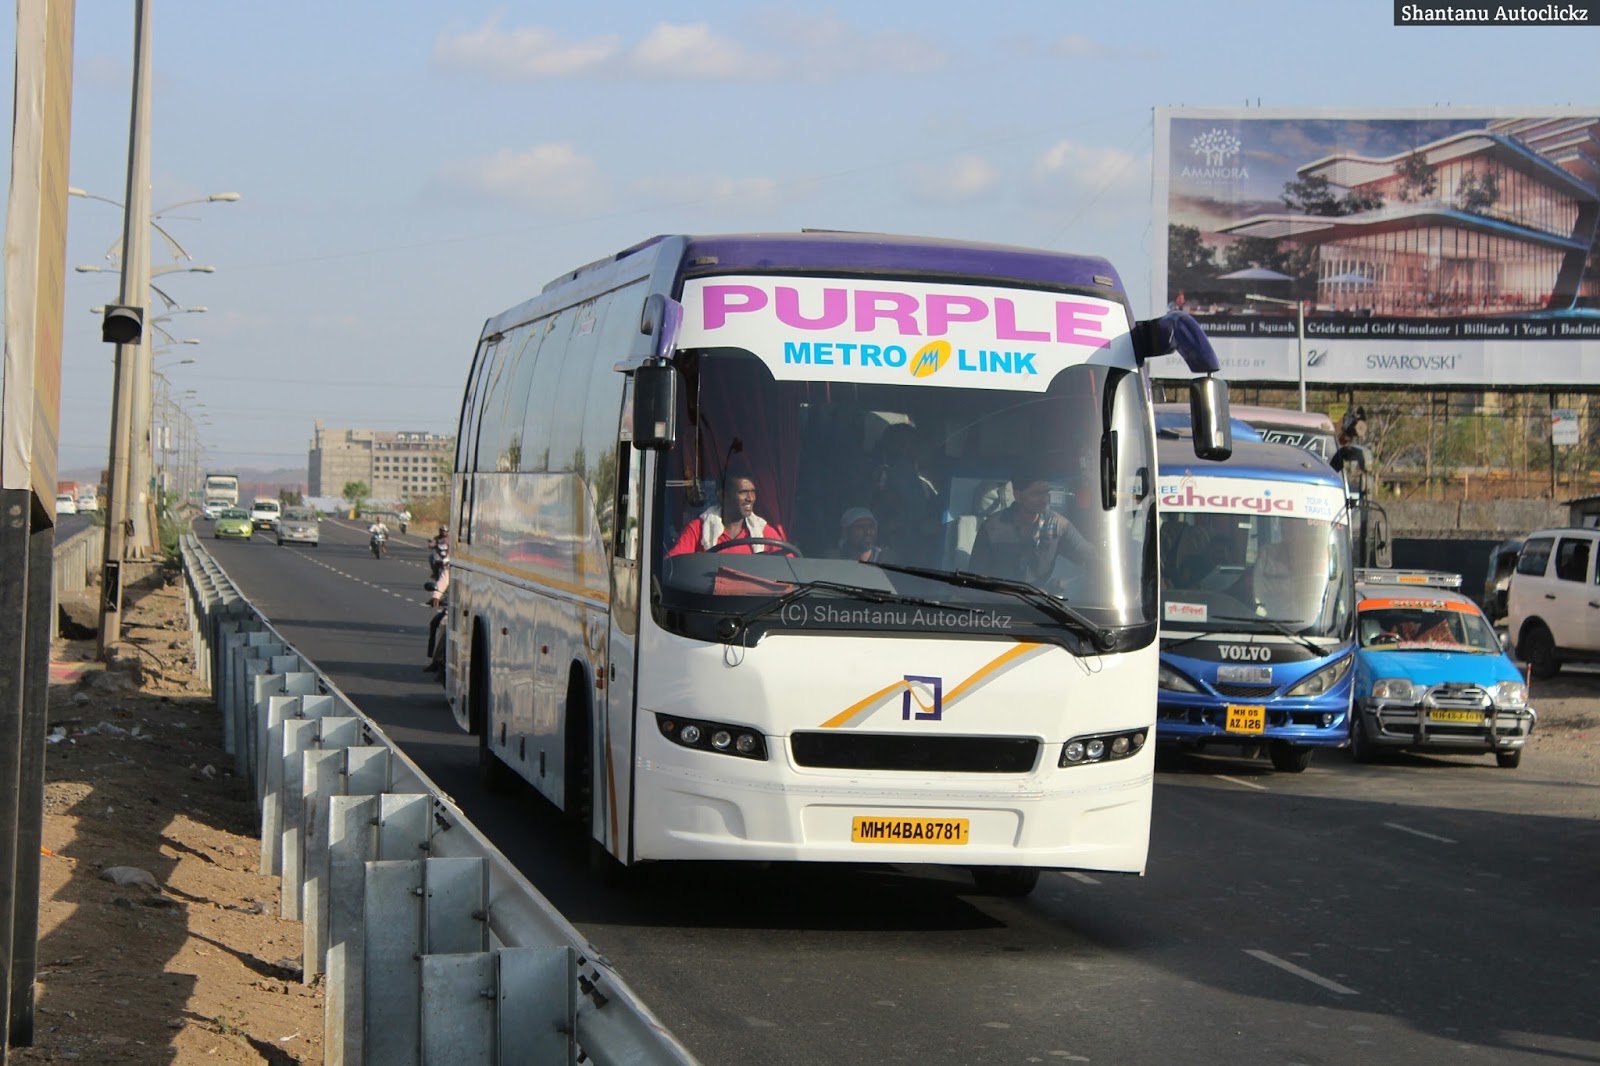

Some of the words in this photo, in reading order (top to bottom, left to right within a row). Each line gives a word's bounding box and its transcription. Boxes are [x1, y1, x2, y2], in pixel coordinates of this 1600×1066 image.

[1181, 167, 1249, 179] AMANORA
[702, 284, 1112, 349] PURPLE
[1259, 322, 1295, 334] Squash
[1307, 322, 1346, 334] Cricket
[1349, 323, 1369, 334] and
[1371, 323, 1395, 335] Golf
[1398, 323, 1450, 335] Simulator
[1464, 324, 1510, 335] Billiards
[1522, 324, 1548, 336] Yoga
[784, 341, 907, 368] METRO
[958, 350, 1038, 375] LINK
[1367, 354, 1456, 371] SWAROVSKI
[1159, 486, 1294, 513] aharaja
[1218, 645, 1271, 661] VOLVO
[861, 821, 961, 840] MH14BA8781
